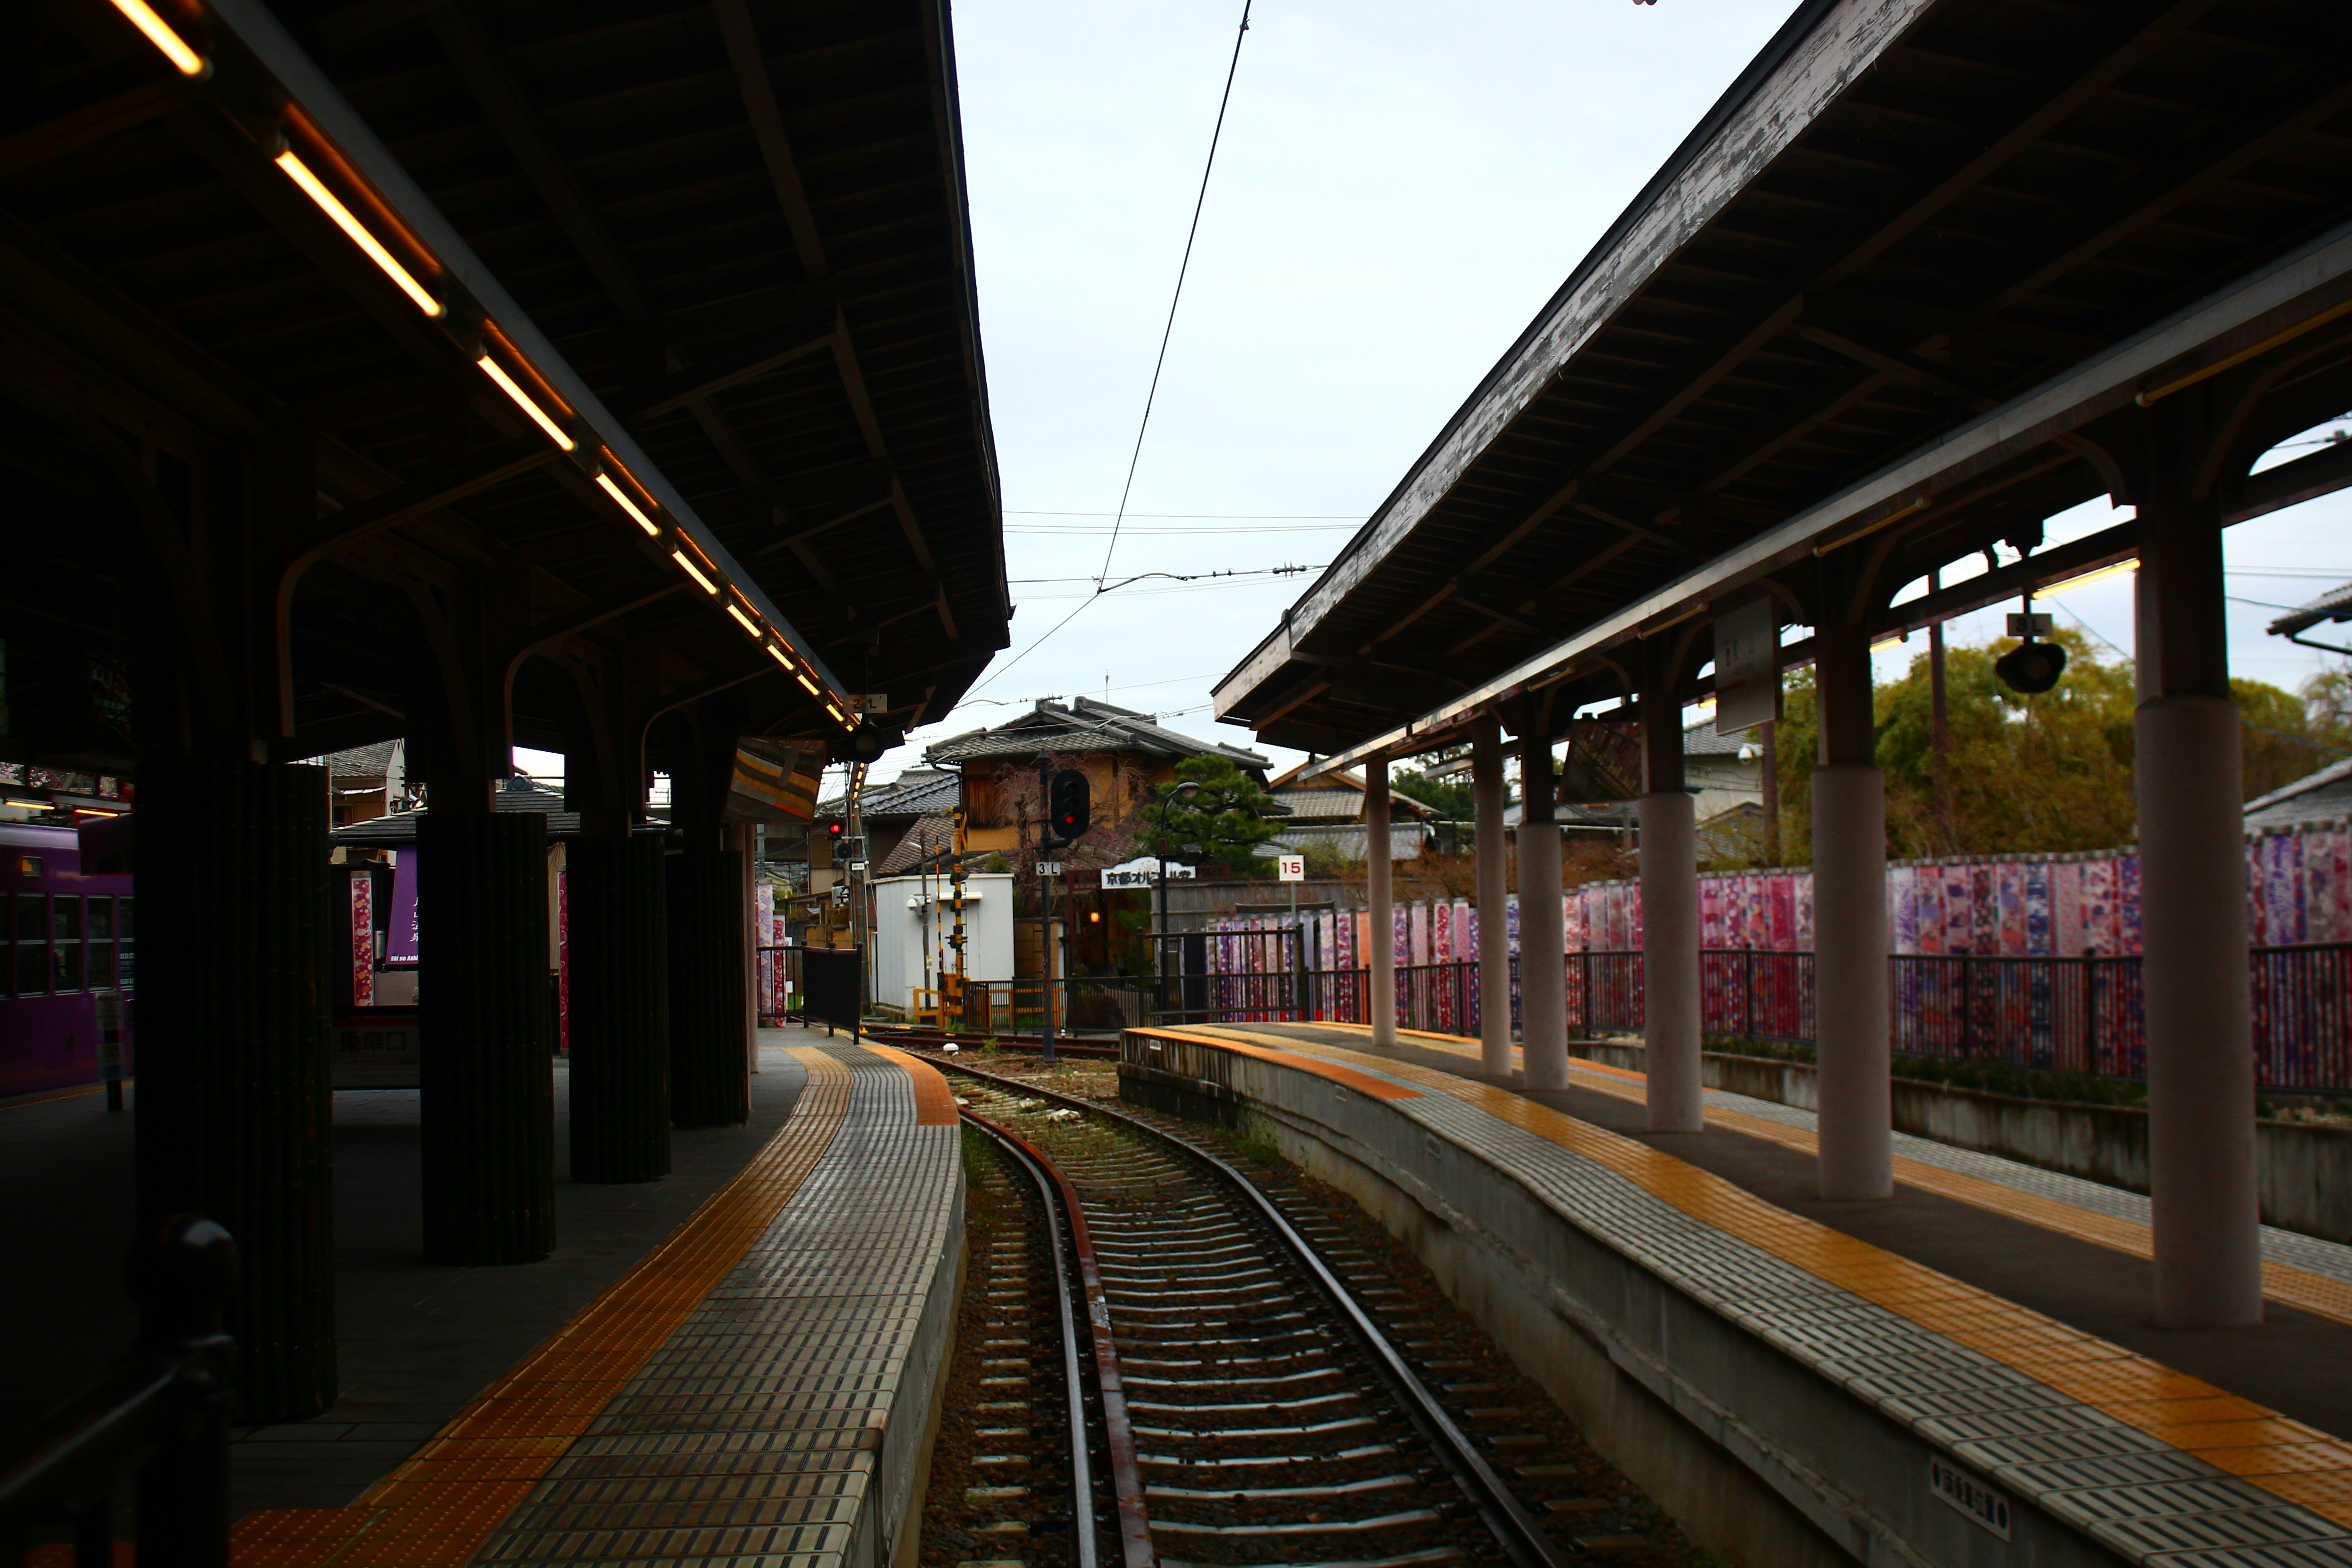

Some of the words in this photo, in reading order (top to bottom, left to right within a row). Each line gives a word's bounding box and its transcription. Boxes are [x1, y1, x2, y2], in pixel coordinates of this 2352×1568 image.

[1039, 863, 1045, 874] 3
[1051, 862, 1057, 874] L
[1282, 862, 1301, 873] 15
[340, 1031, 406, 1053] 乗車口
